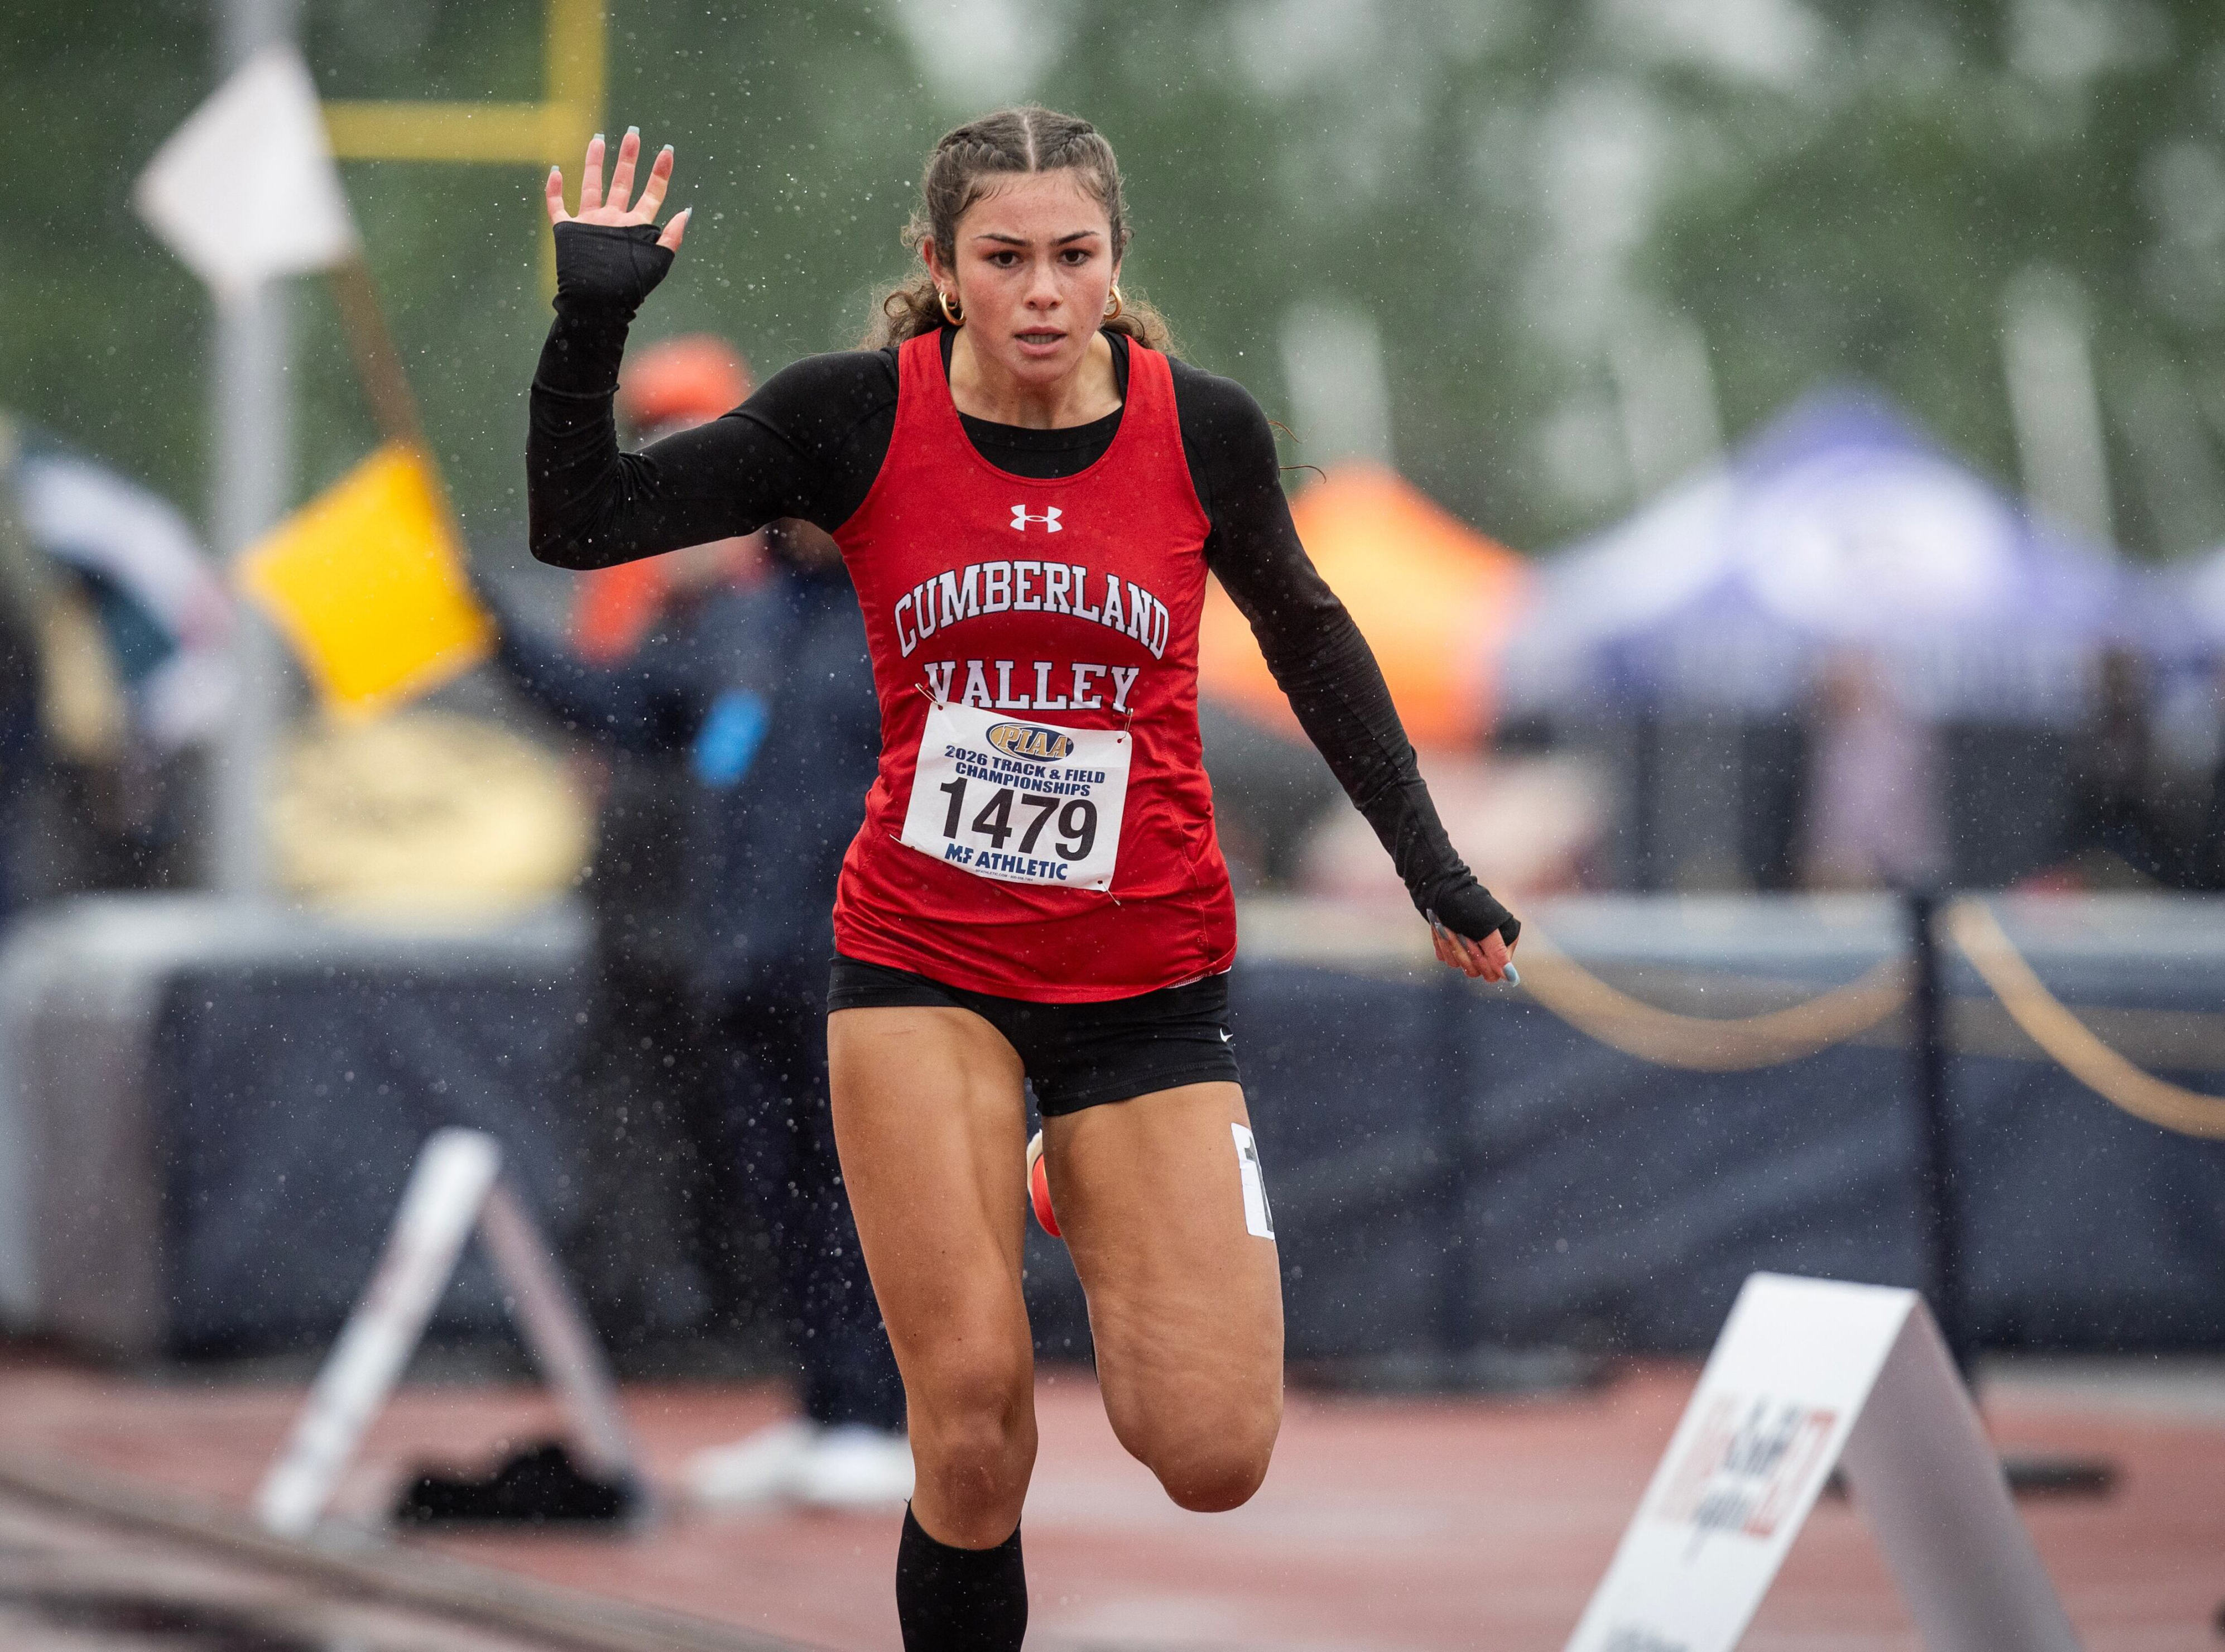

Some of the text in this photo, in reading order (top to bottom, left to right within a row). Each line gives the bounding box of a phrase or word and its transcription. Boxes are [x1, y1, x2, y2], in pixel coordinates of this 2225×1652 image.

[894, 560, 1170, 660] CUMBERLAND
[924, 660, 1140, 713] VALLEY
[997, 726, 1068, 758] PIAA
[944, 745, 1106, 784] 2026 TRACK & FIELD
[955, 762, 1091, 796] CHAMPIONSHIPS
[940, 776, 1098, 861] 1479
[975, 851, 1068, 880] ATHLETIC
